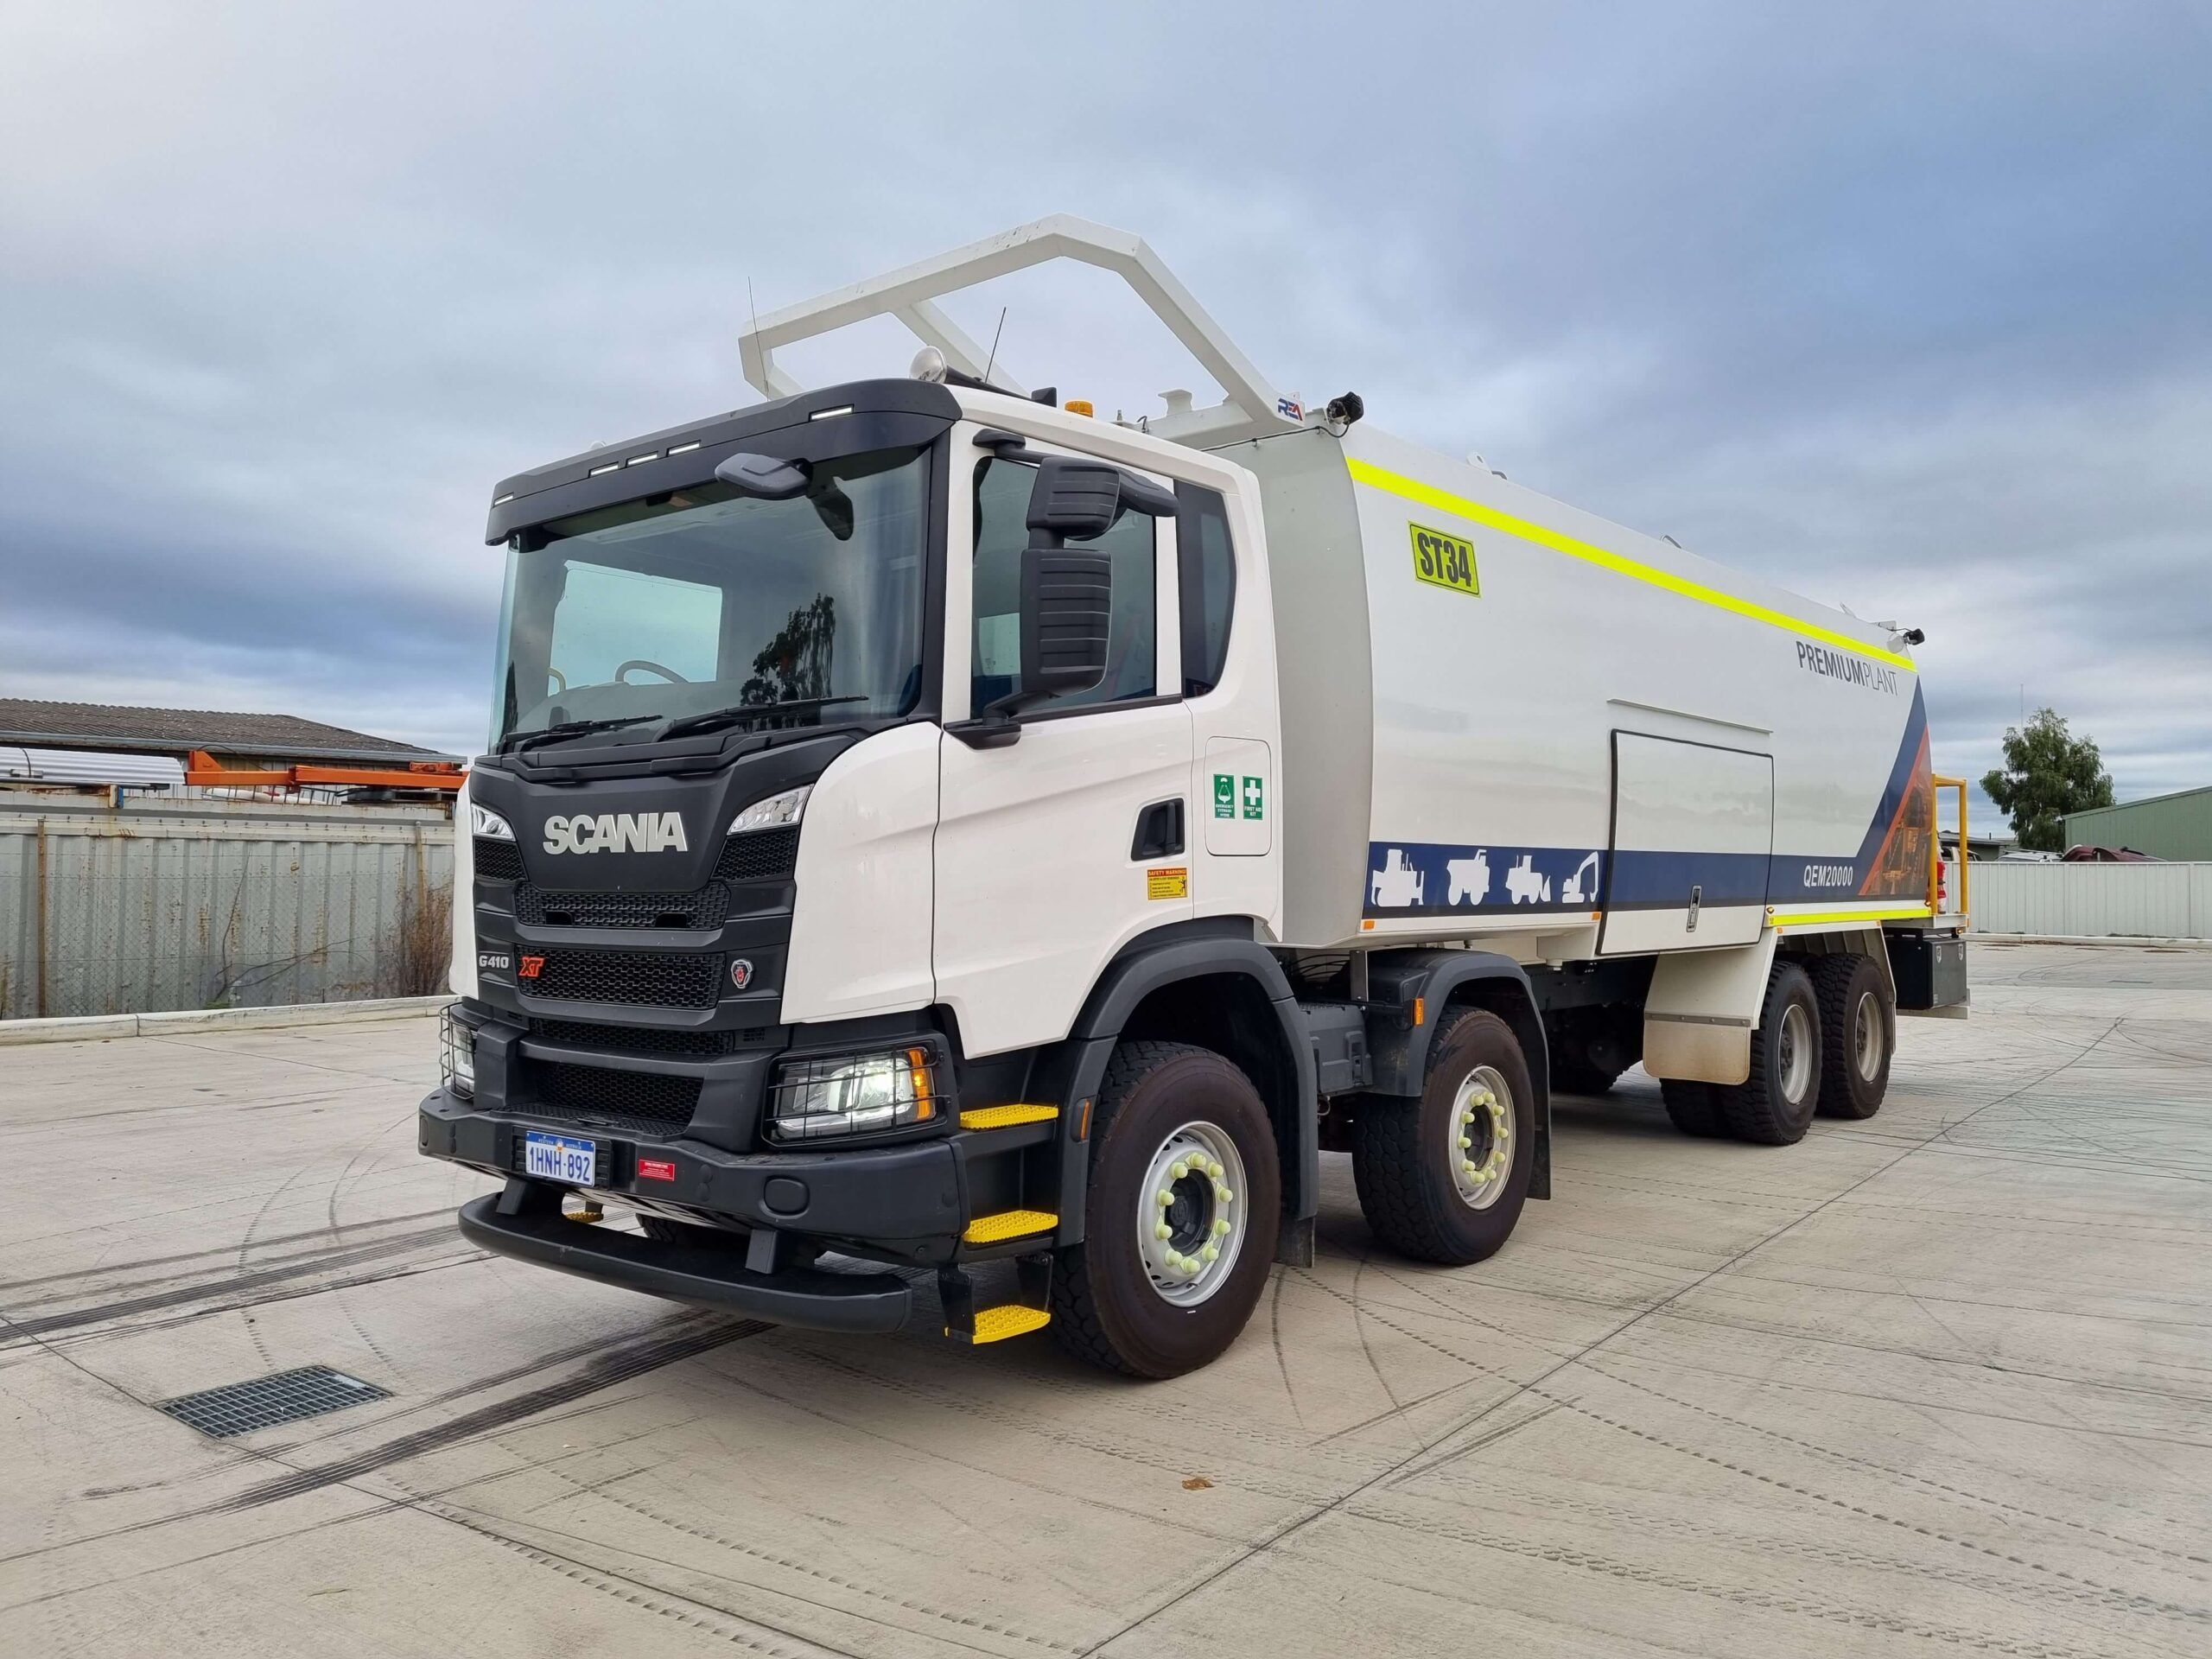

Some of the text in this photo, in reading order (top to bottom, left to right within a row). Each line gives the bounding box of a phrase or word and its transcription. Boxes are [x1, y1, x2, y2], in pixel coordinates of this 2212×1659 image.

[1277, 397, 1303, 421] REA
[1417, 531, 1471, 588] ST34
[543, 811, 689, 855] SCANIA
[1803, 865, 1853, 888] QEM20000
[479, 955, 510, 969] G410
[518, 956, 546, 977] XT
